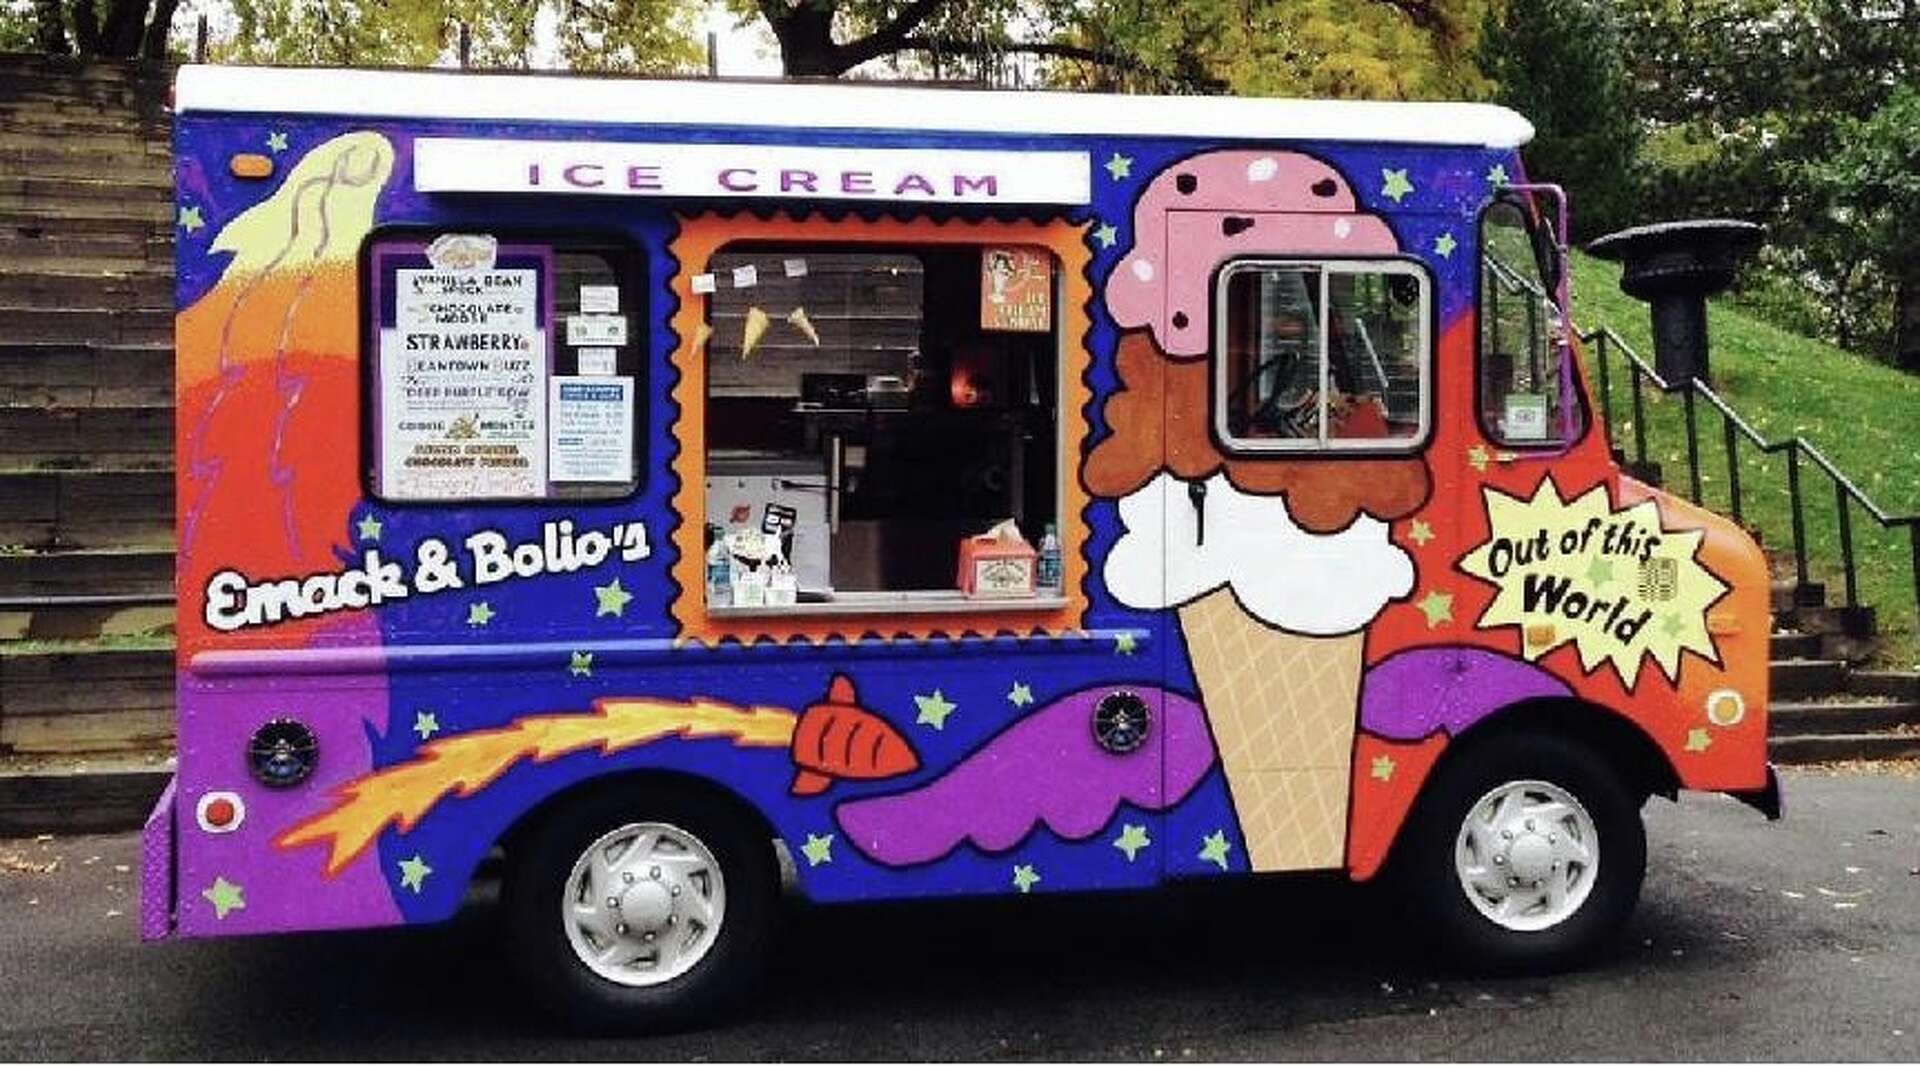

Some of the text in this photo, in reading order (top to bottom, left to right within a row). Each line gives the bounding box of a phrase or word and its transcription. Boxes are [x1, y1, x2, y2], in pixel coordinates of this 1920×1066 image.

[528, 164, 998, 197] ICE CREAM
[406, 333, 522, 351] STRAWBERRY
[206, 519, 651, 631] Emack & Bolio's
[1488, 517, 1662, 578] Out of this
[1523, 573, 1653, 646] World
